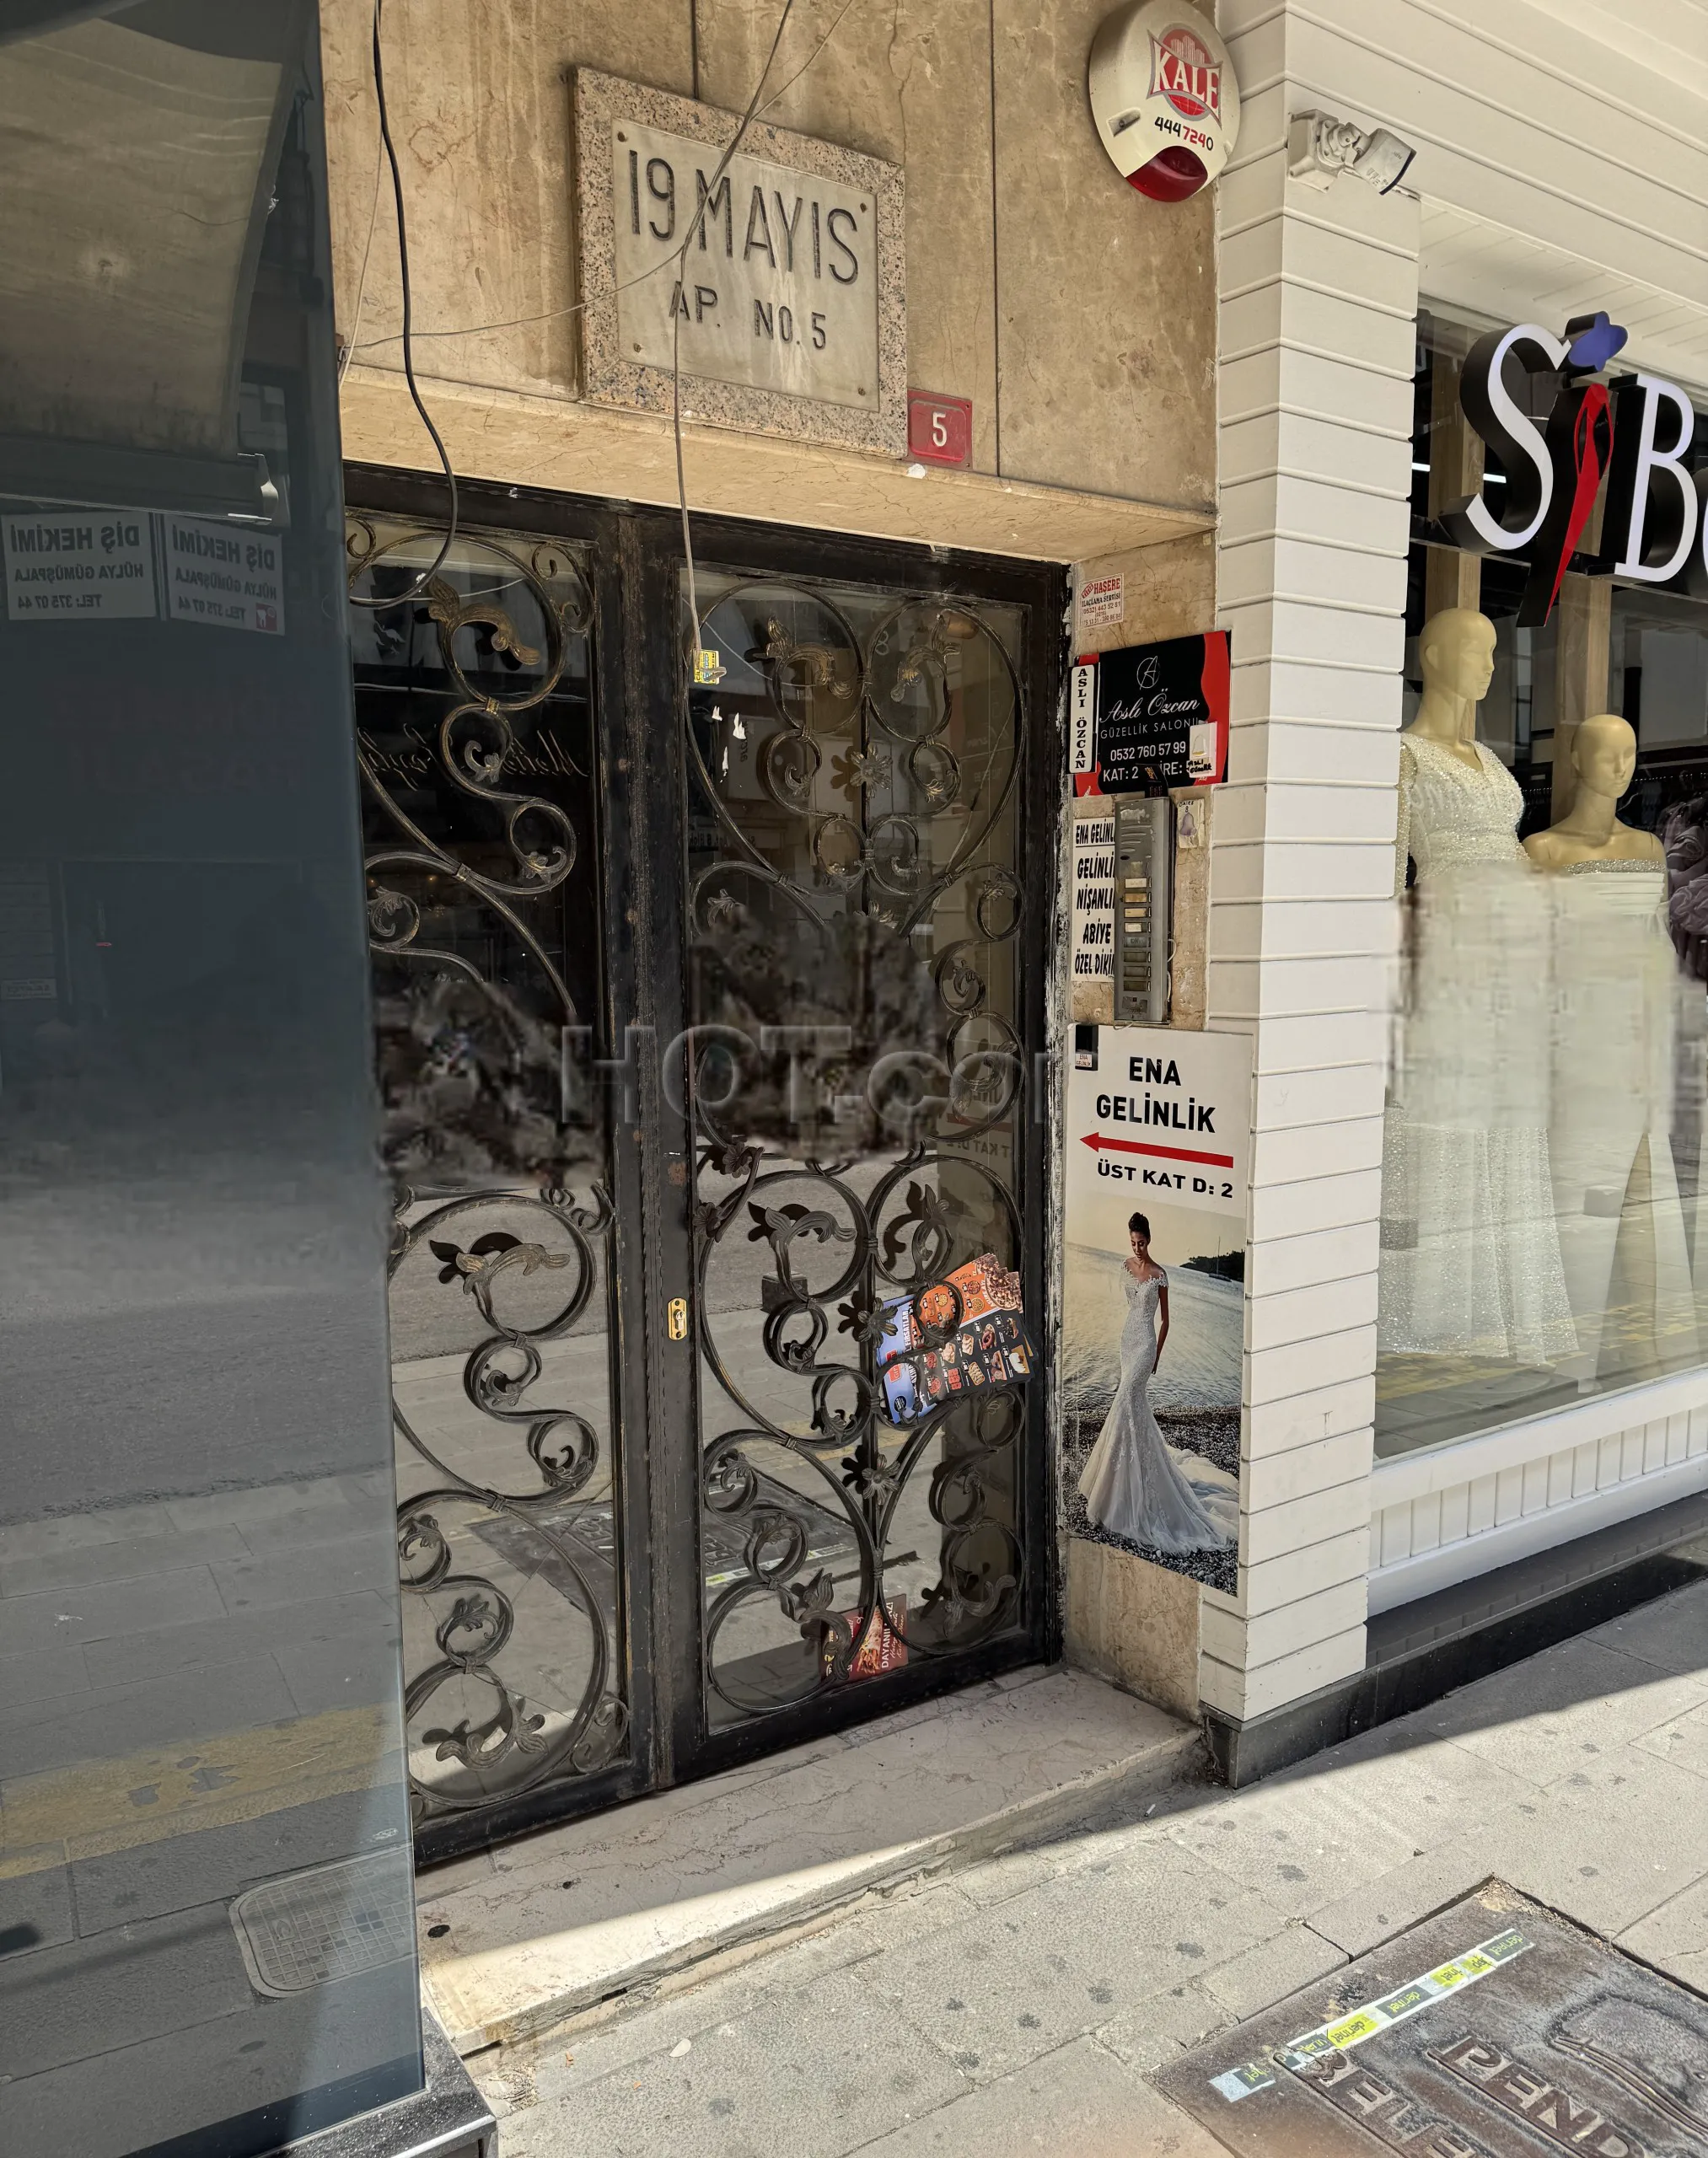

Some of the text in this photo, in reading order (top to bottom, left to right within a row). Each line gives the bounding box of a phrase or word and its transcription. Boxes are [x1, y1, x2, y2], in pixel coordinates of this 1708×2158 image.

[1152, 45, 1220, 115] KALE
[629, 149, 859, 285] 19 MAYIS
[669, 281, 721, 328] AP.
[811, 313, 826, 350] 5
[932, 412, 948, 448] 5
[1077, 668, 1088, 707] ASLI
[1099, 687, 1200, 722] Aslı Özcan
[1076, 717, 1087, 769] ÖZCAN
[1100, 721, 1148, 739] GÜZELLİK
[1110, 741, 1186, 761] 0532 760 57 99
[1082, 918, 1111, 945] ABİYE
[1075, 949, 1093, 974] ÖZEL
[1130, 1056, 1181, 1086] ENA
[1097, 1092, 1216, 1133] GELİNLİK
[1098, 1158, 1136, 1181] ÜST
[1143, 1170, 1185, 1189] KAT
[1389, 1990, 1421, 2014] derinet
[1332, 2020, 1367, 2043] derinet
